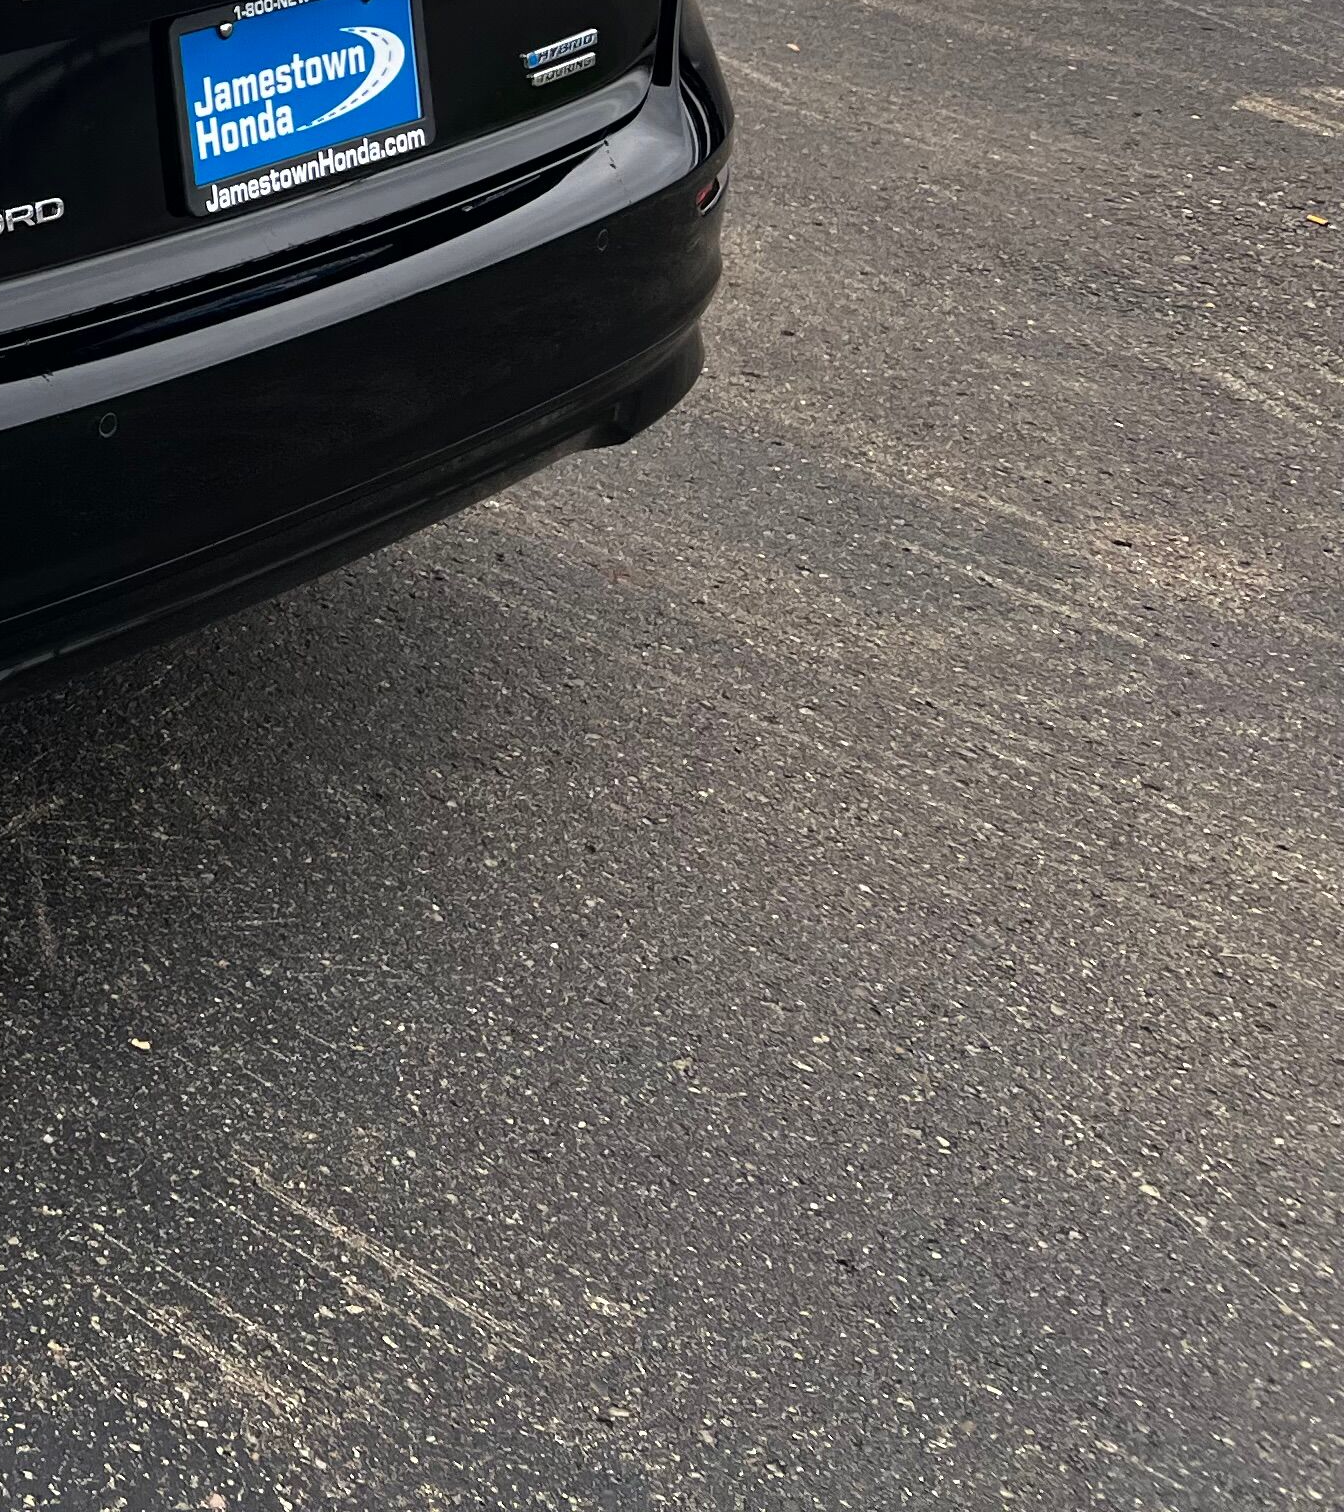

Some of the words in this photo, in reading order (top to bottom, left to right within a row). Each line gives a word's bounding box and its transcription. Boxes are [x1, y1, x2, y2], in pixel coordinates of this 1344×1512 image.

[194, 44, 366, 118] Jamestown
[538, 33, 594, 64] HYBRID
[196, 103, 295, 161] Honda
[205, 127, 426, 213] JamestownHonda.com
